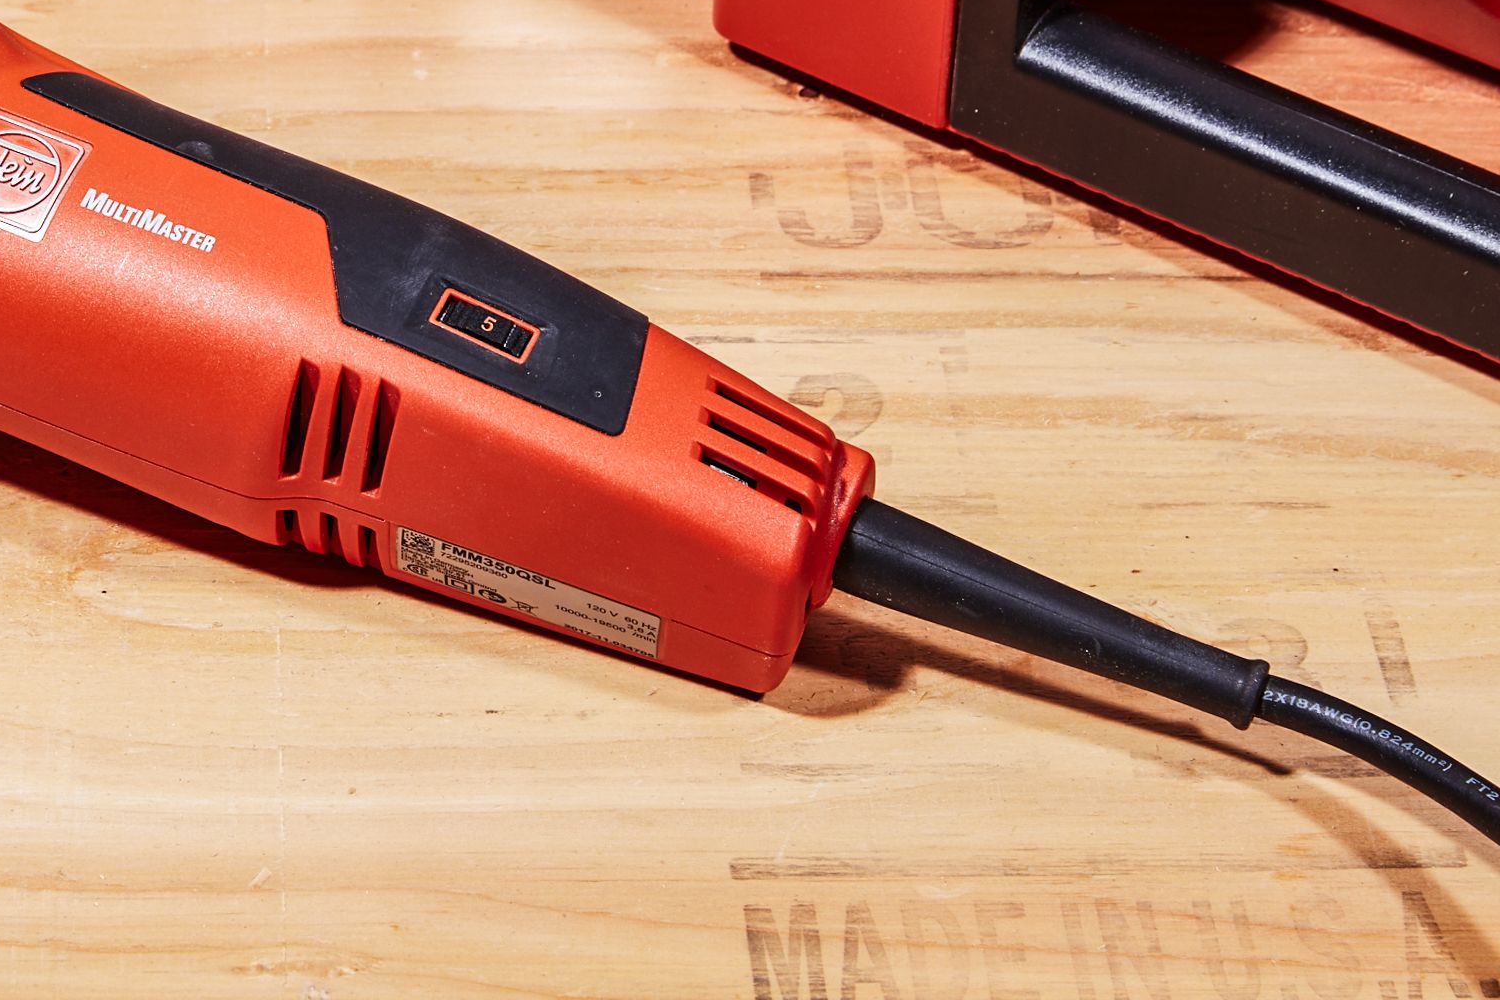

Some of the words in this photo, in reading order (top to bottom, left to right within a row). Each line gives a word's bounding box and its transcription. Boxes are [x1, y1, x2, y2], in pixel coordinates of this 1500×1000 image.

[480, 315, 497, 332] 5
[441, 542, 556, 590] FMM350QSL
[586, 602, 607, 614] 120
[609, 610, 619, 618] V
[624, 616, 639, 626] 60
[641, 622, 657, 632] Hz
[647, 631, 656, 639] A
[743, 899, 1041, 1000] MADE
[1059, 897, 1172, 1000] IN
